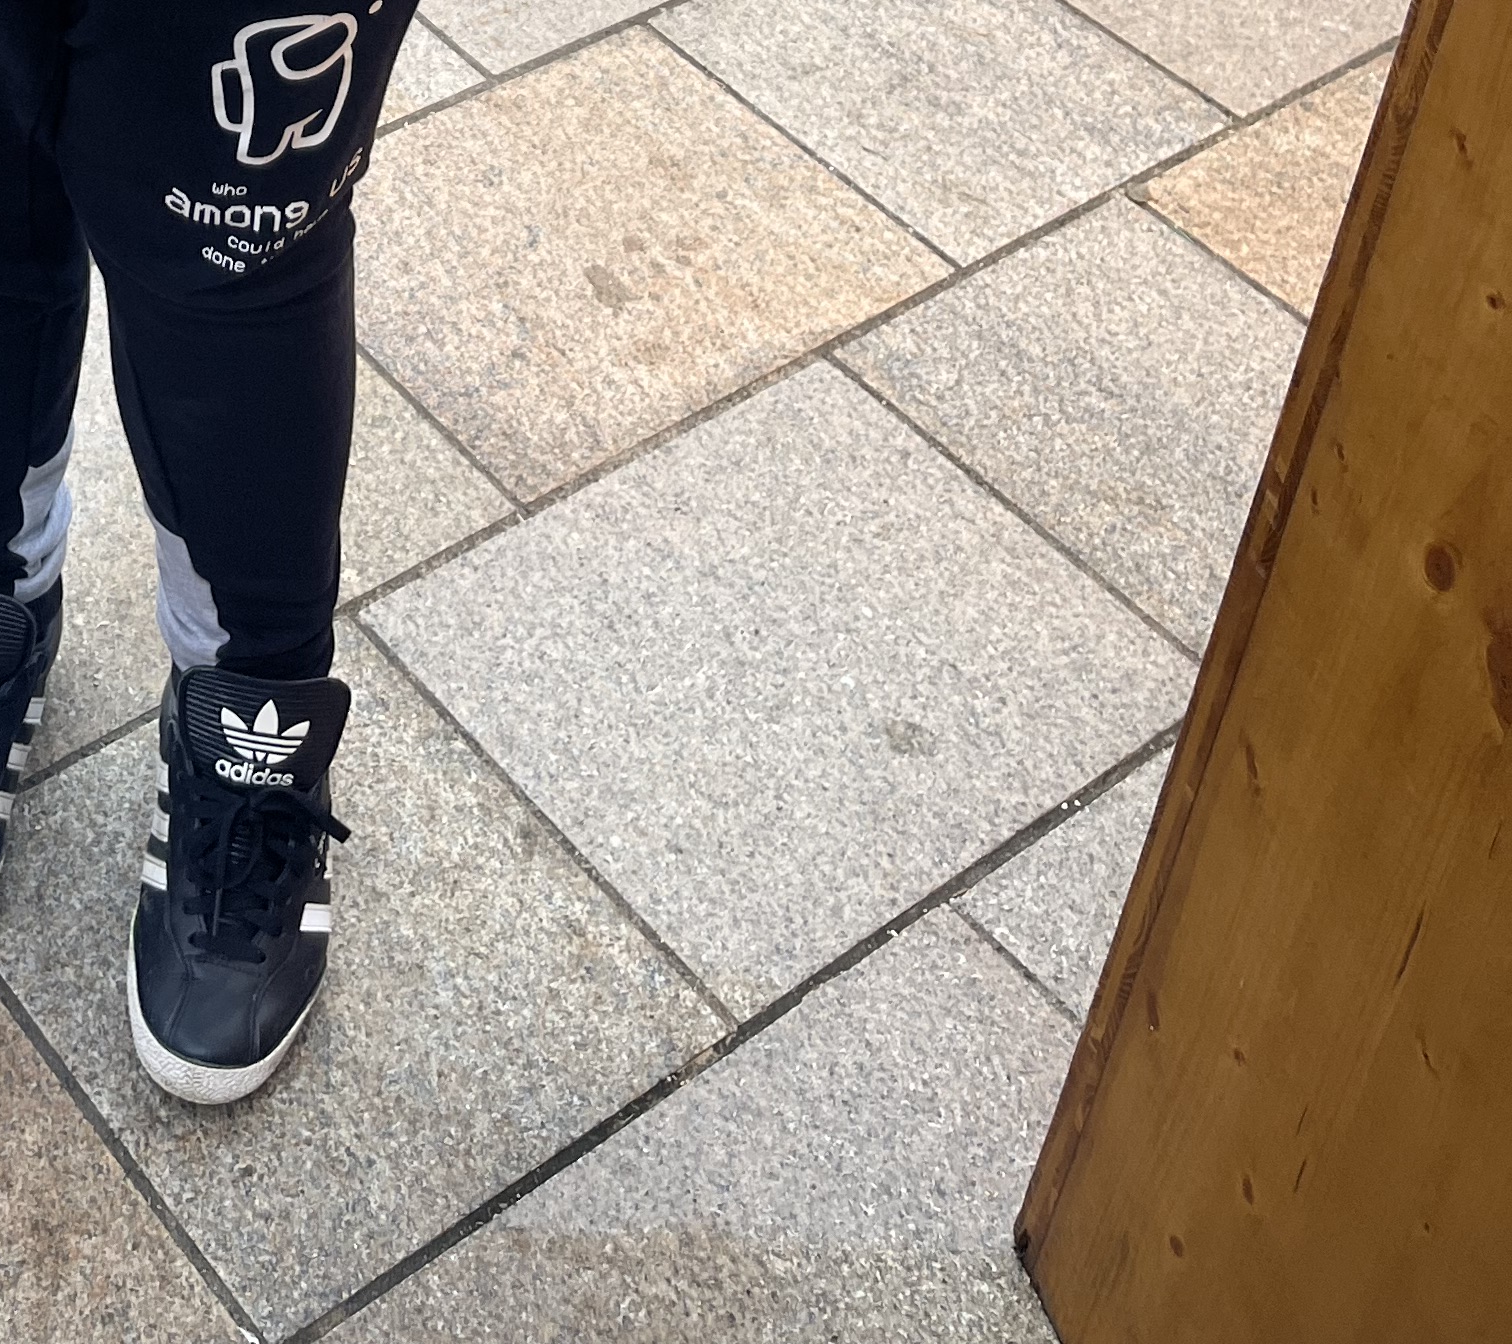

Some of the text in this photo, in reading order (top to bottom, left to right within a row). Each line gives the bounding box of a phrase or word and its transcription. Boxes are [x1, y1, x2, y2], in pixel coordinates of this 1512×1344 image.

[211, 182, 248, 197] who
[164, 186, 310, 232] among
[227, 234, 286, 254] could
[201, 245, 247, 273] done
[215, 758, 295, 787] adidas
